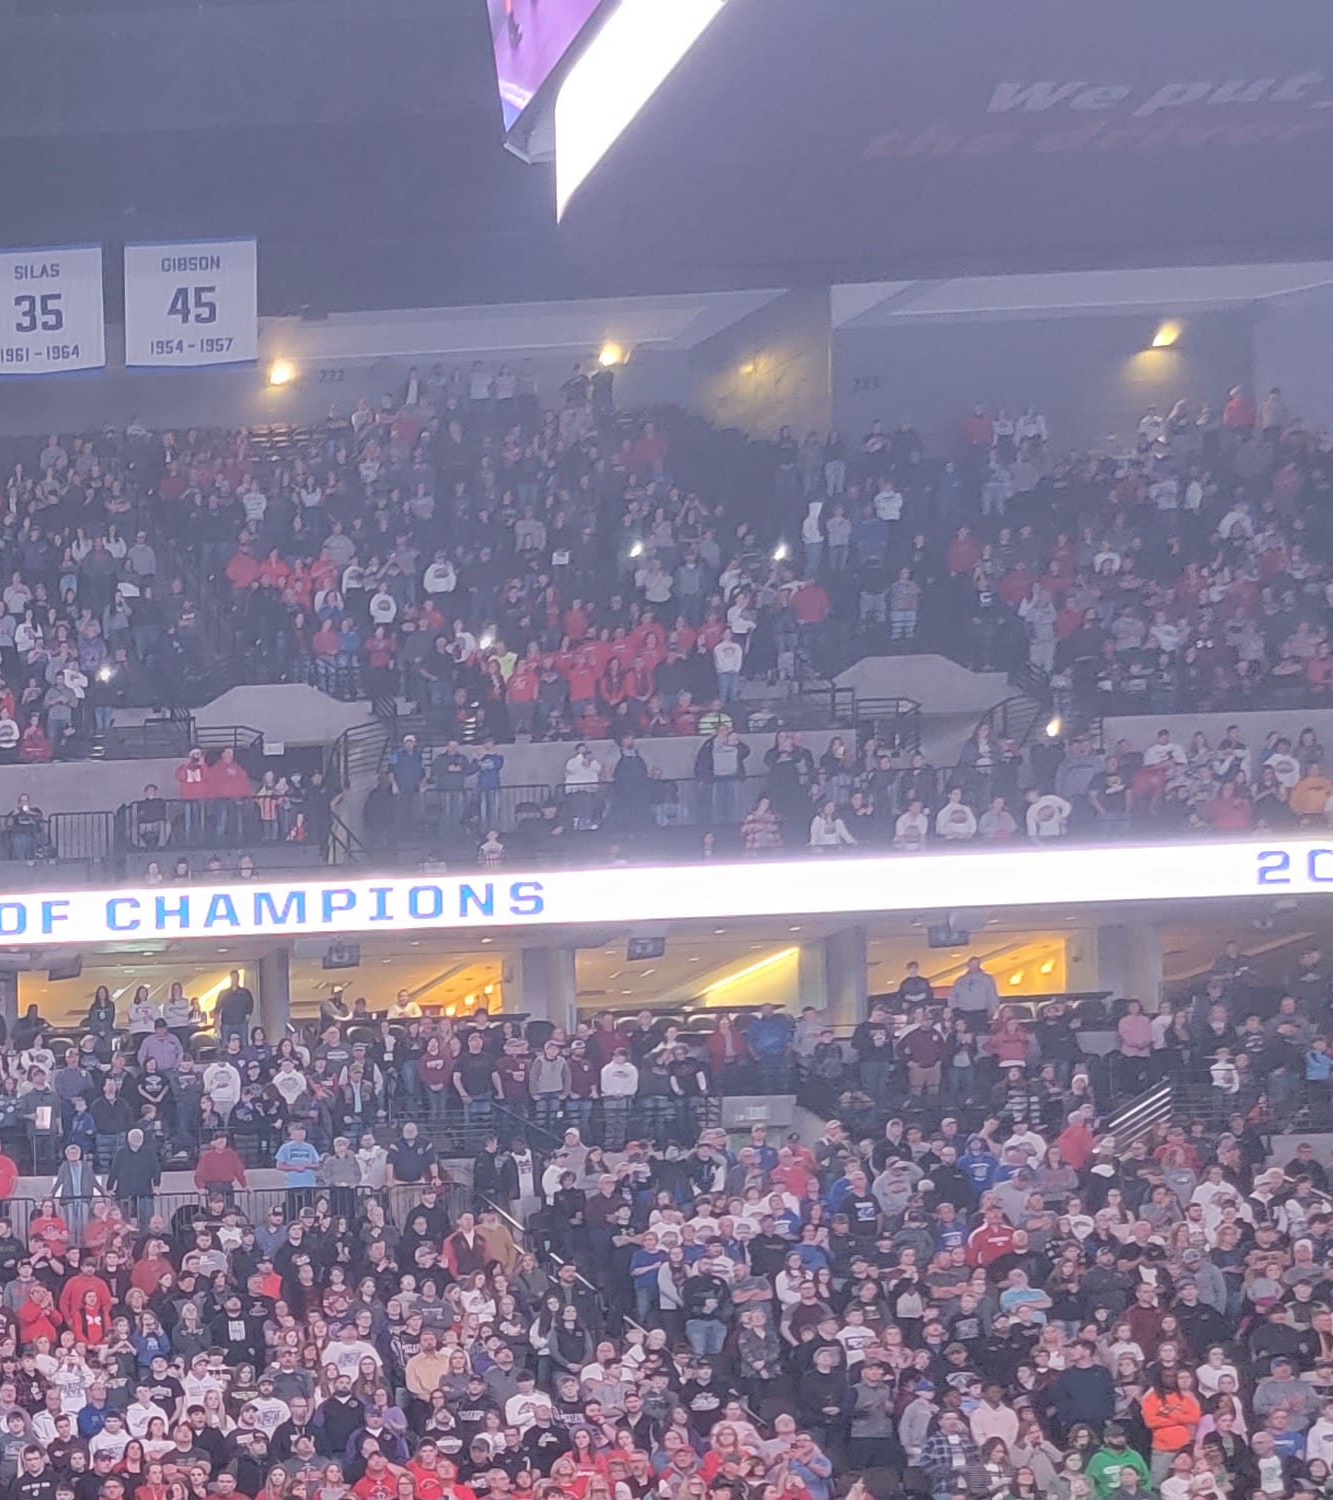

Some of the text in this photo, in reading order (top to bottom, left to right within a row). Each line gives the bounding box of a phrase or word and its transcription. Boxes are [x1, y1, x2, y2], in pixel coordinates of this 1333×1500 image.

[985, 72, 1325, 117] We put
[13, 264, 60, 280] SILAS
[160, 256, 221, 273] GIBSON
[13, 293, 64, 333] 35
[166, 286, 217, 325] 45
[106, 882, 544, 932] CHAMPIONS
